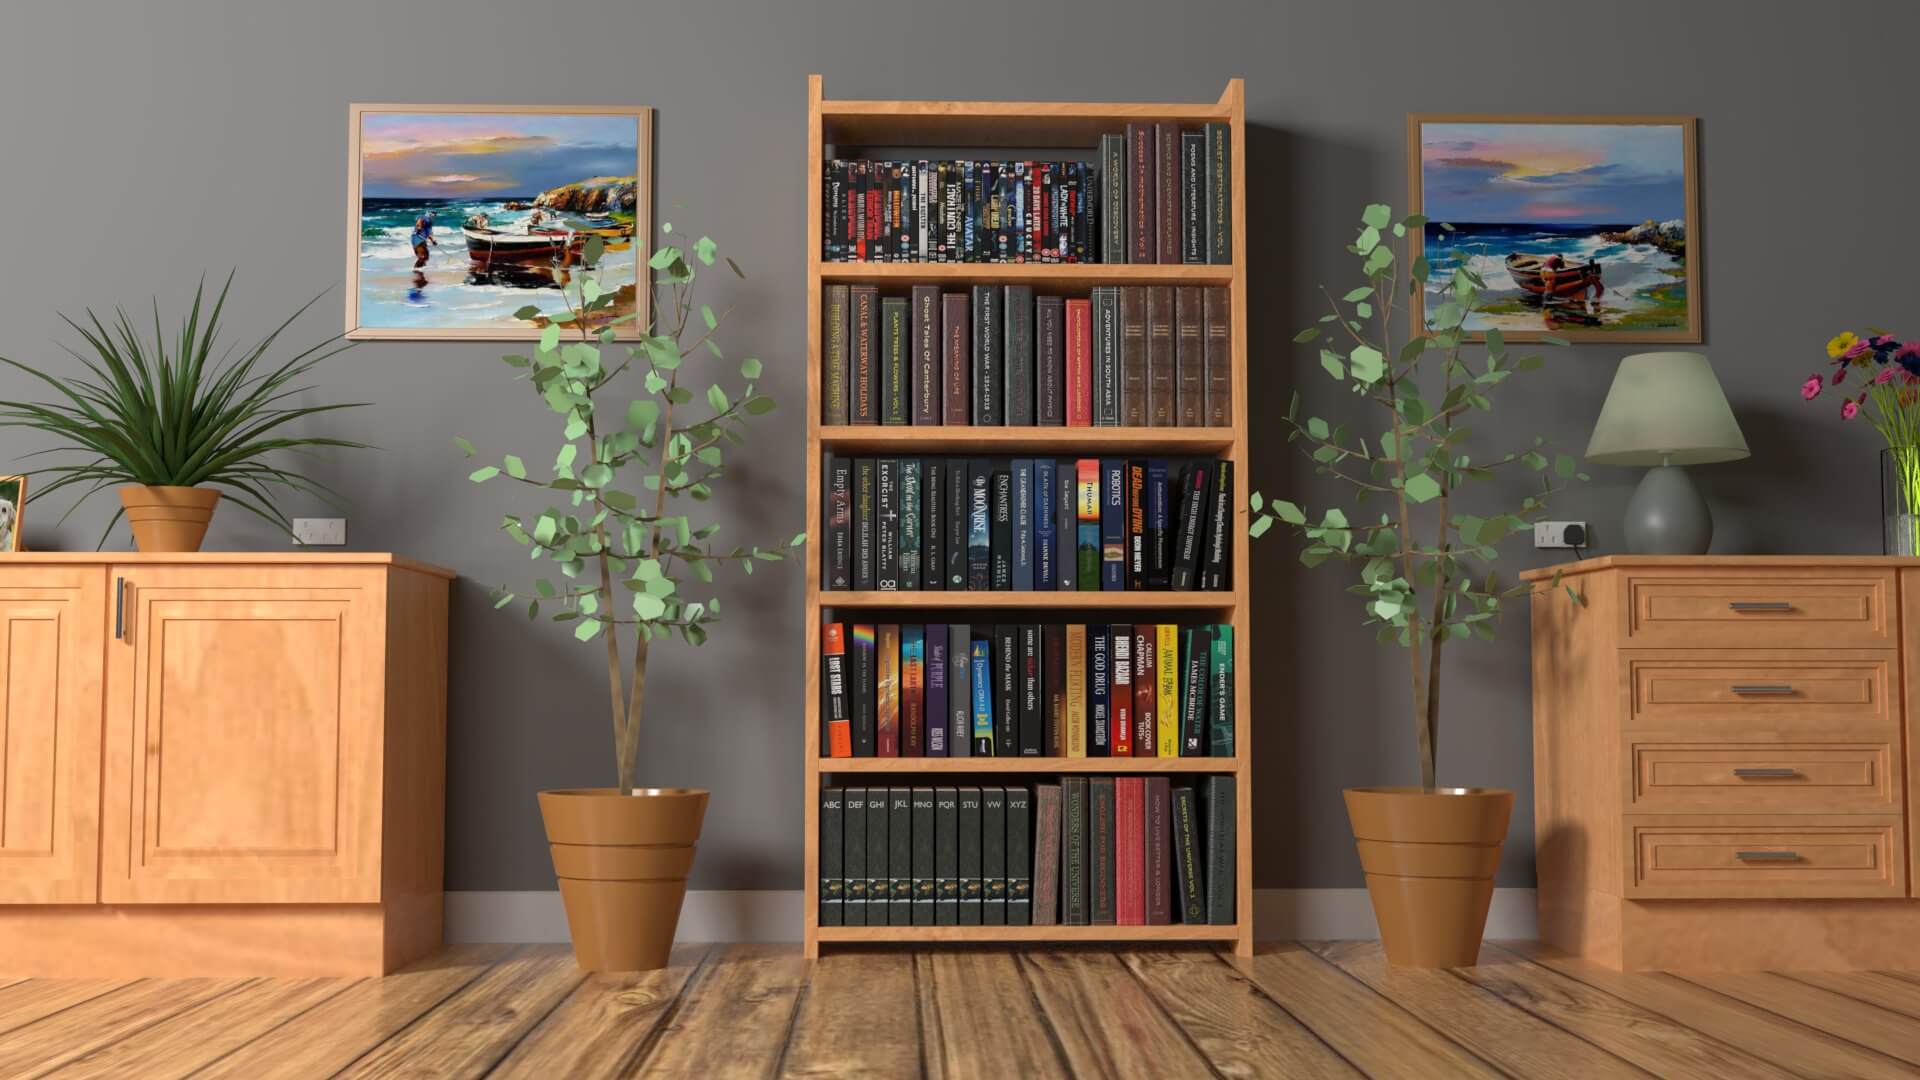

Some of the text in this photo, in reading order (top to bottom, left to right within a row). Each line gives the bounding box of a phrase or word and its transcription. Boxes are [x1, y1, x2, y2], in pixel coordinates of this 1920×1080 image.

[1060, 184, 1068, 227] LADY WHITE
[1112, 189, 1118, 198] OF
[965, 216, 973, 252] AVATAR
[860, 294, 868, 321] CANAL
[860, 328, 868, 376] WATERWAY
[924, 350, 930, 361] Of
[953, 372, 960, 380] OF
[860, 378, 868, 417] HOLIDAYS
[834, 469, 847, 523] Empty Arms
[999, 474, 1008, 522] ENCHANTRESS
[1112, 470, 1120, 506] ROBOTICS
[1132, 466, 1142, 534] DEAD DYING
[829, 657, 840, 672] LOST
[1095, 636, 1105, 695] THE GOD DRUG
[830, 674, 842, 695] STARS
[1188, 685, 1197, 721] MCBRIDE
[894, 800, 907, 809] JKL
[938, 801, 954, 809] PQR
[1155, 815, 1160, 825] TO
[1184, 824, 1189, 833] OF
[1072, 792, 1080, 908] WONDERS OF THE UNIVERSE
